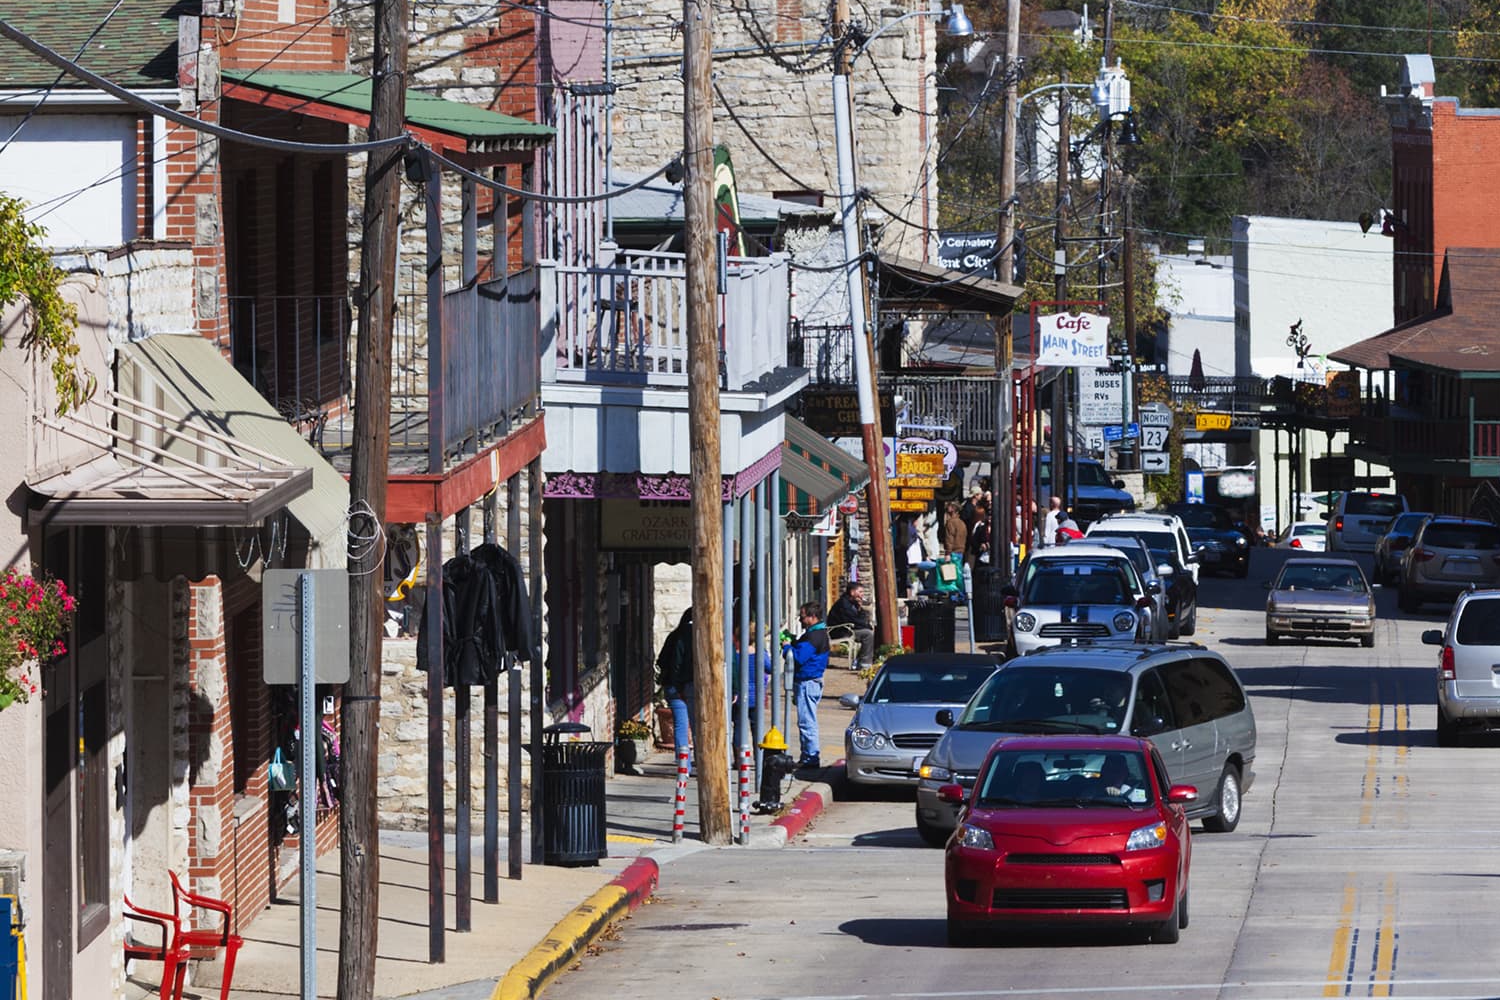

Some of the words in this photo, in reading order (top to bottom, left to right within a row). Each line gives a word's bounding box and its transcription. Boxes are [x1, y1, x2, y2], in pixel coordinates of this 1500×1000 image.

[946, 237, 996, 248] Cemetery
[939, 255, 960, 268] lent
[1056, 316, 1091, 334] Cafe
[1043, 334, 1068, 355] MAIN
[1071, 338, 1104, 357] STREET
[1094, 380, 1120, 389] BUSES
[1094, 393, 1110, 401] RVs
[1143, 414, 1169, 423] NORTH
[1090, 439, 1103, 449] 15
[1147, 431, 1162, 446] 23
[901, 461, 936, 475] BARREL
